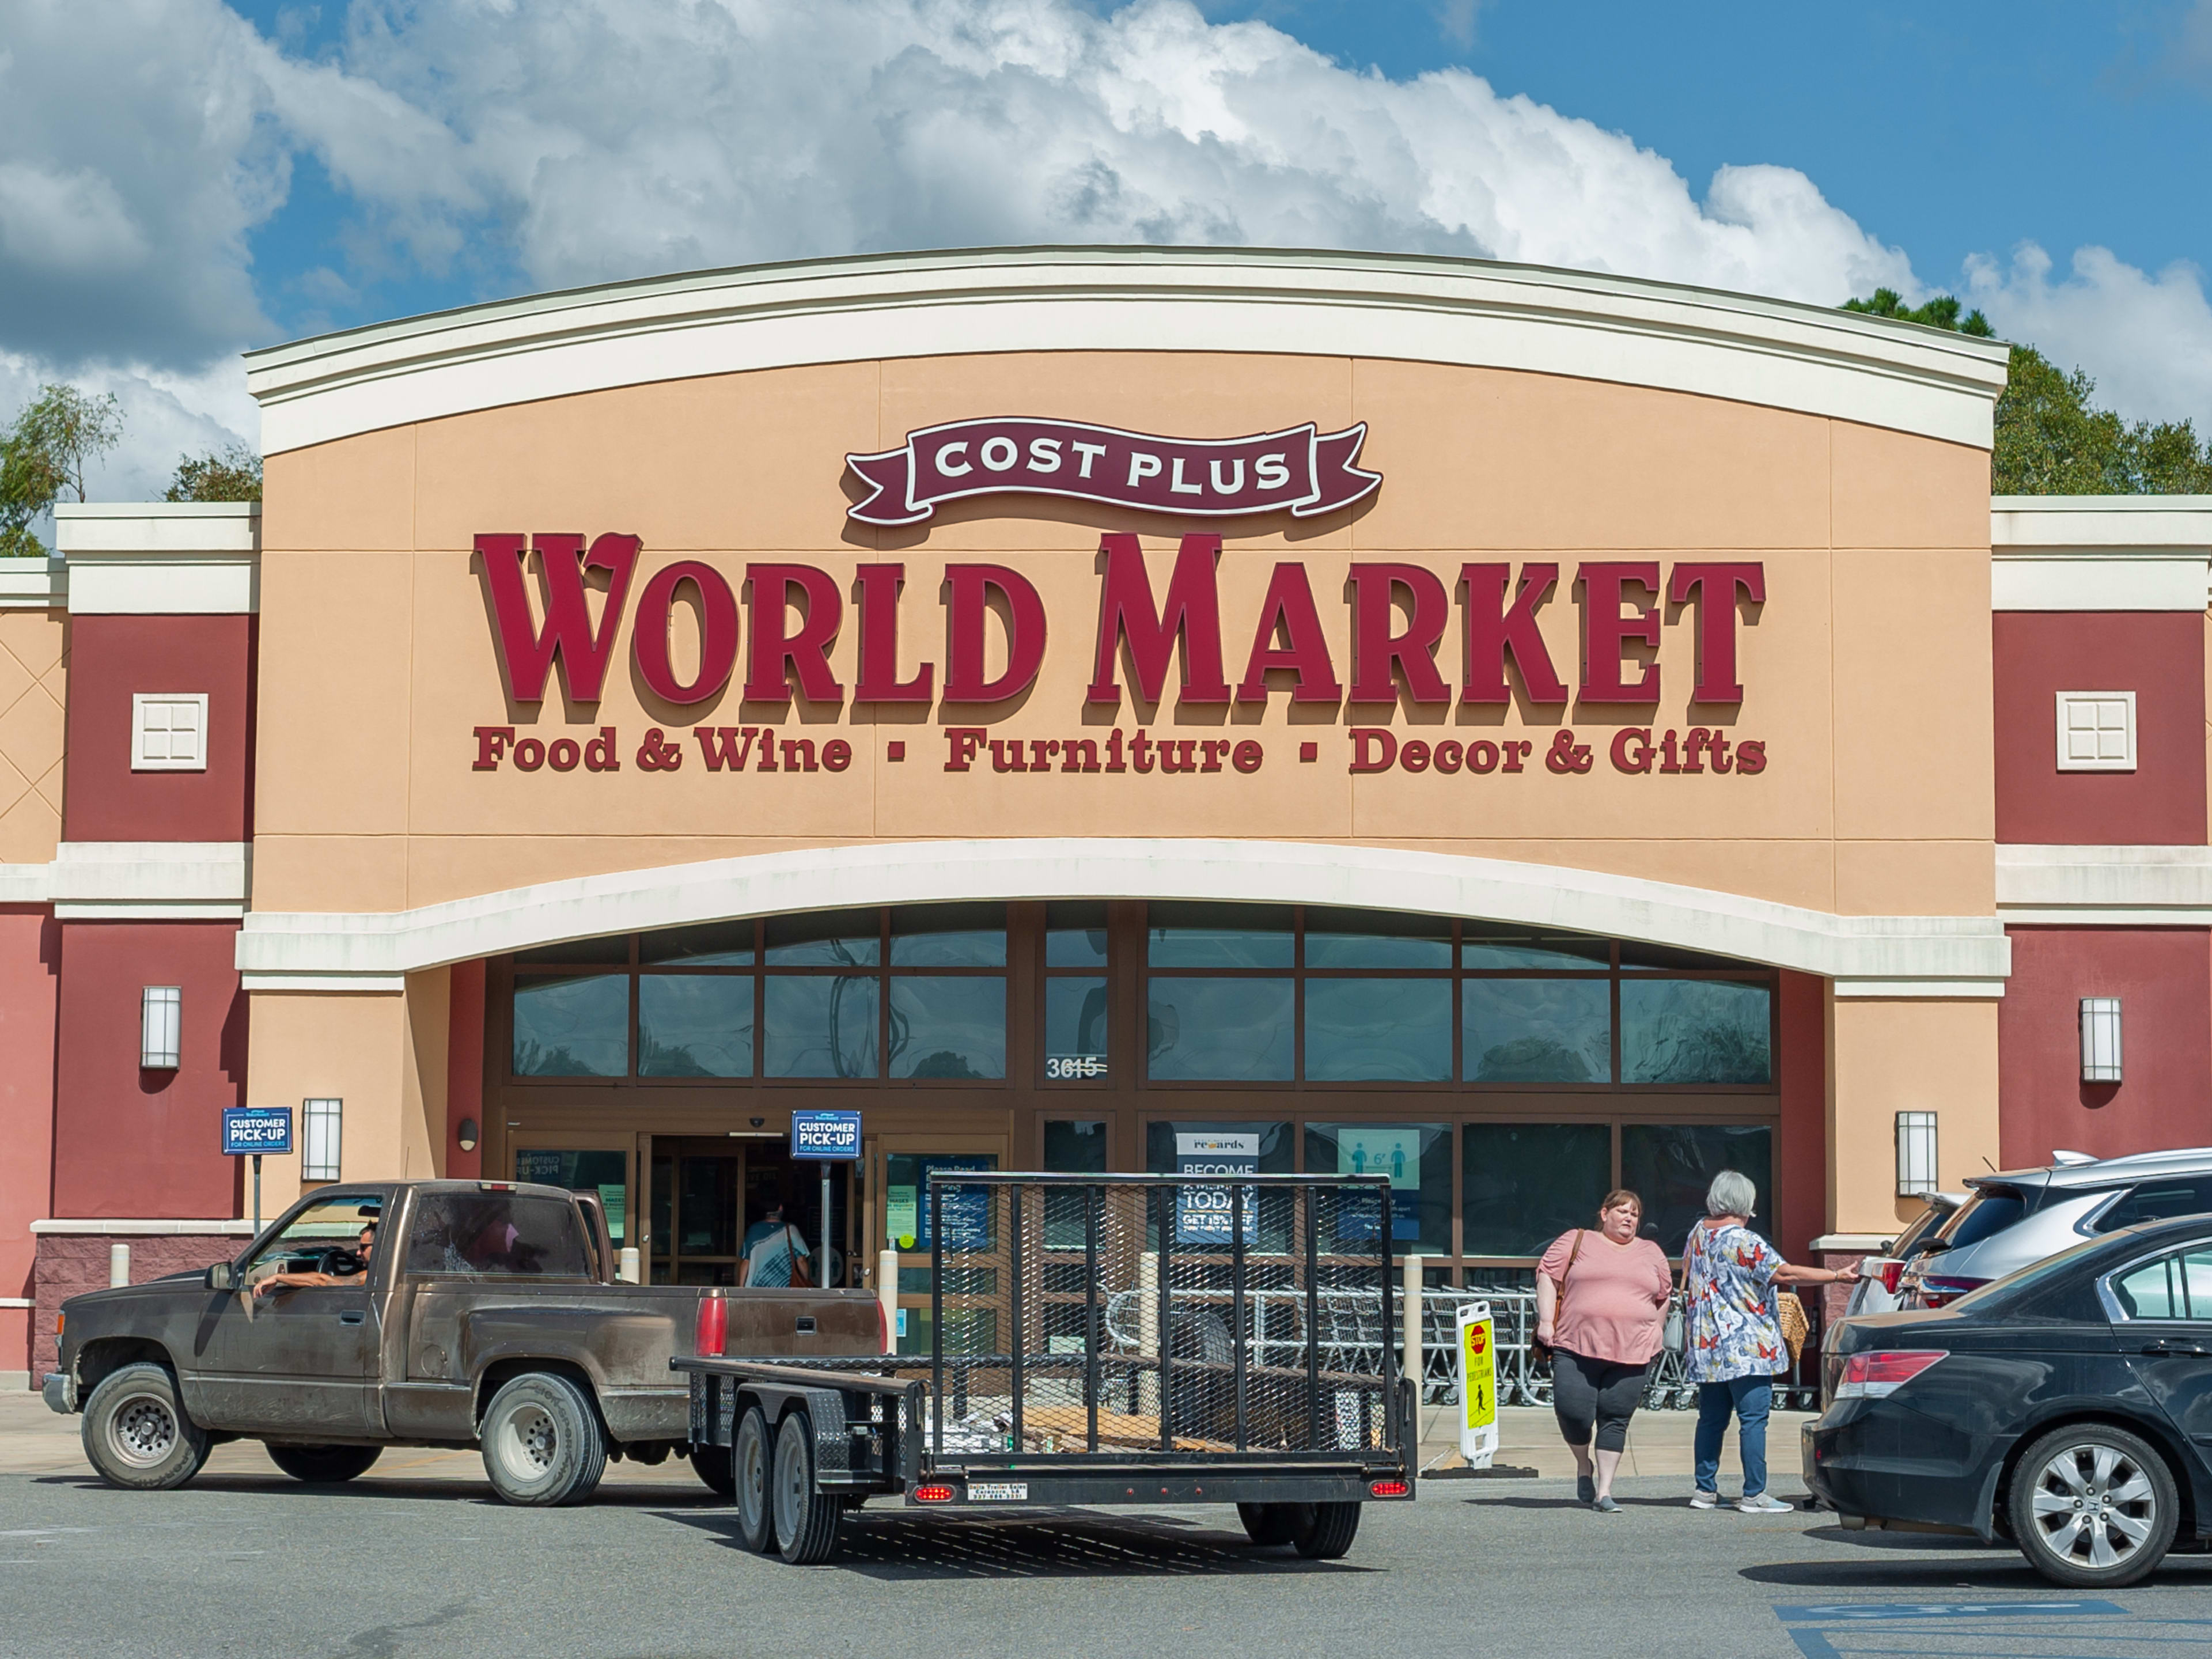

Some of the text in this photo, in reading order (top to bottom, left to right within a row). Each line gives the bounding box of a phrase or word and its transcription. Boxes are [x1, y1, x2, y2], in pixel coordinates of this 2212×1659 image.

[935, 436, 1291, 497] COST PLUS
[474, 531, 1766, 704] WORLD MARKET
[472, 726, 1768, 775] Food & Wine Furniture Decor & Gifts
[1047, 1056, 1097, 1078] 3615
[230, 1119, 285, 1128] CUSTOMER
[799, 1123, 855, 1132] CUSTOMER
[231, 1129, 285, 1141] PICK-UP
[800, 1133, 855, 1145] PICK-UP
[1471, 1334, 1484, 1346] STOP
[1475, 1357, 1483, 1366] FOR
